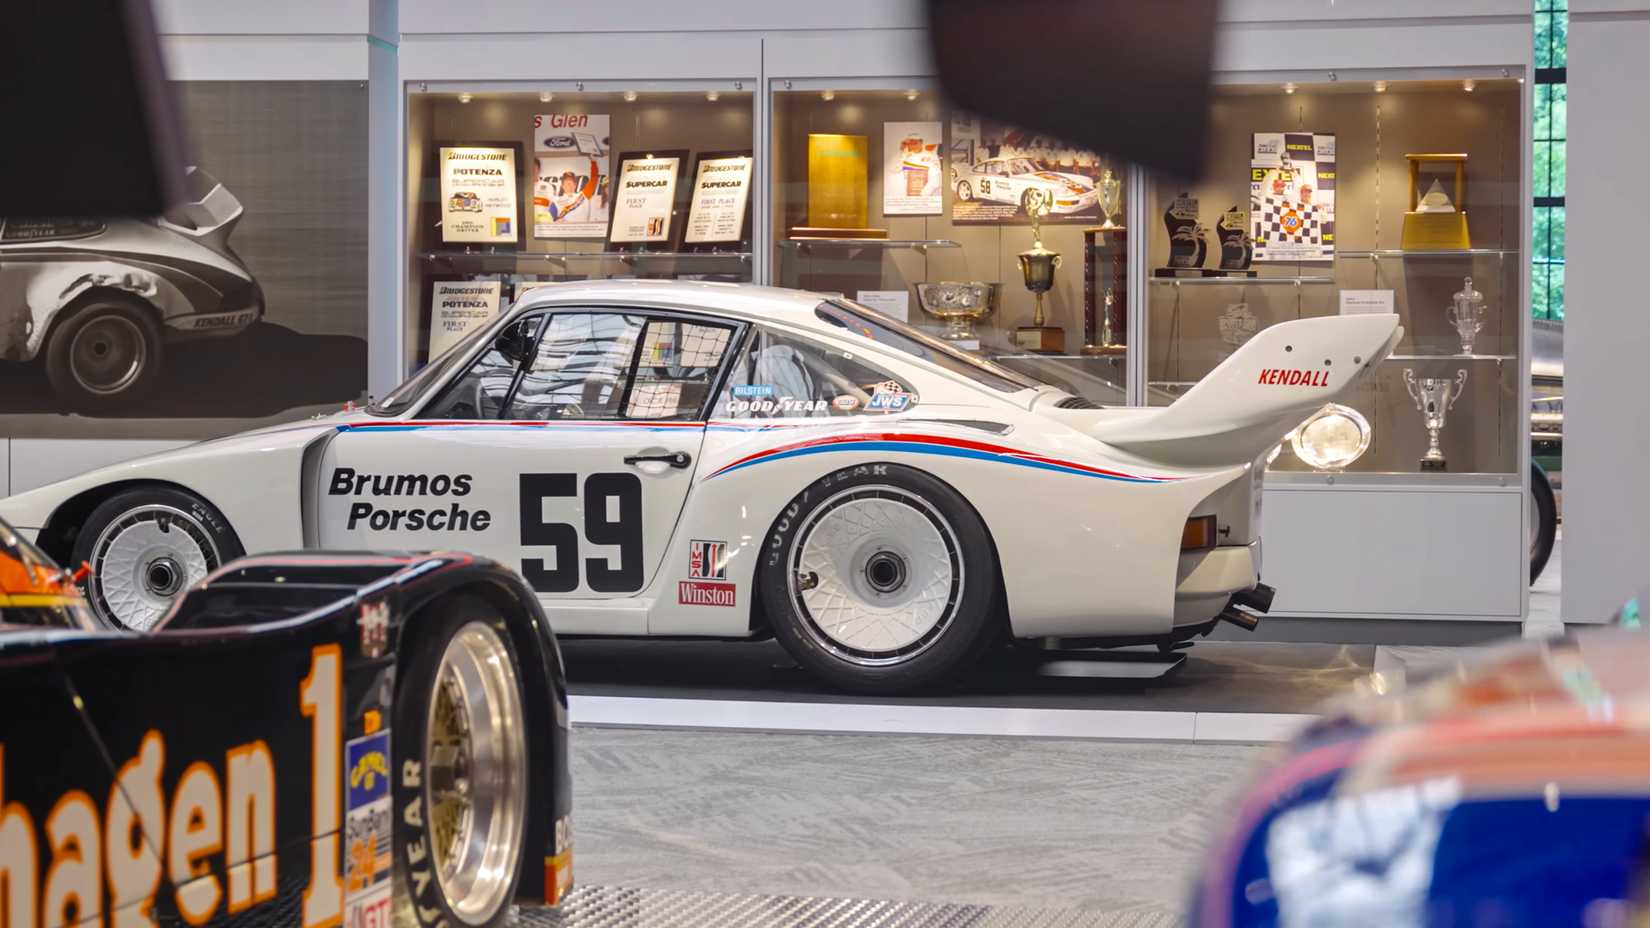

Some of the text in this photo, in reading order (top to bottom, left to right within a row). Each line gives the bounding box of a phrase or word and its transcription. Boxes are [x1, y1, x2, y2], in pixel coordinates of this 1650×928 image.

[453, 168, 503, 176] POTENZA
[626, 180, 668, 188] SUPERCAR
[701, 180, 742, 189] SUPERCAR
[440, 286, 494, 295] BRIDGESTONE
[1258, 368, 1329, 387] KENDALL
[734, 384, 772, 396] BILSTEIN
[726, 397, 828, 415] GOODYEAR
[871, 394, 902, 408] JWS
[329, 467, 472, 496] Brumos
[347, 502, 492, 531] Porsche
[519, 472, 645, 593] 59
[691, 542, 702, 577] IMSA
[680, 583, 734, 605] Winston
